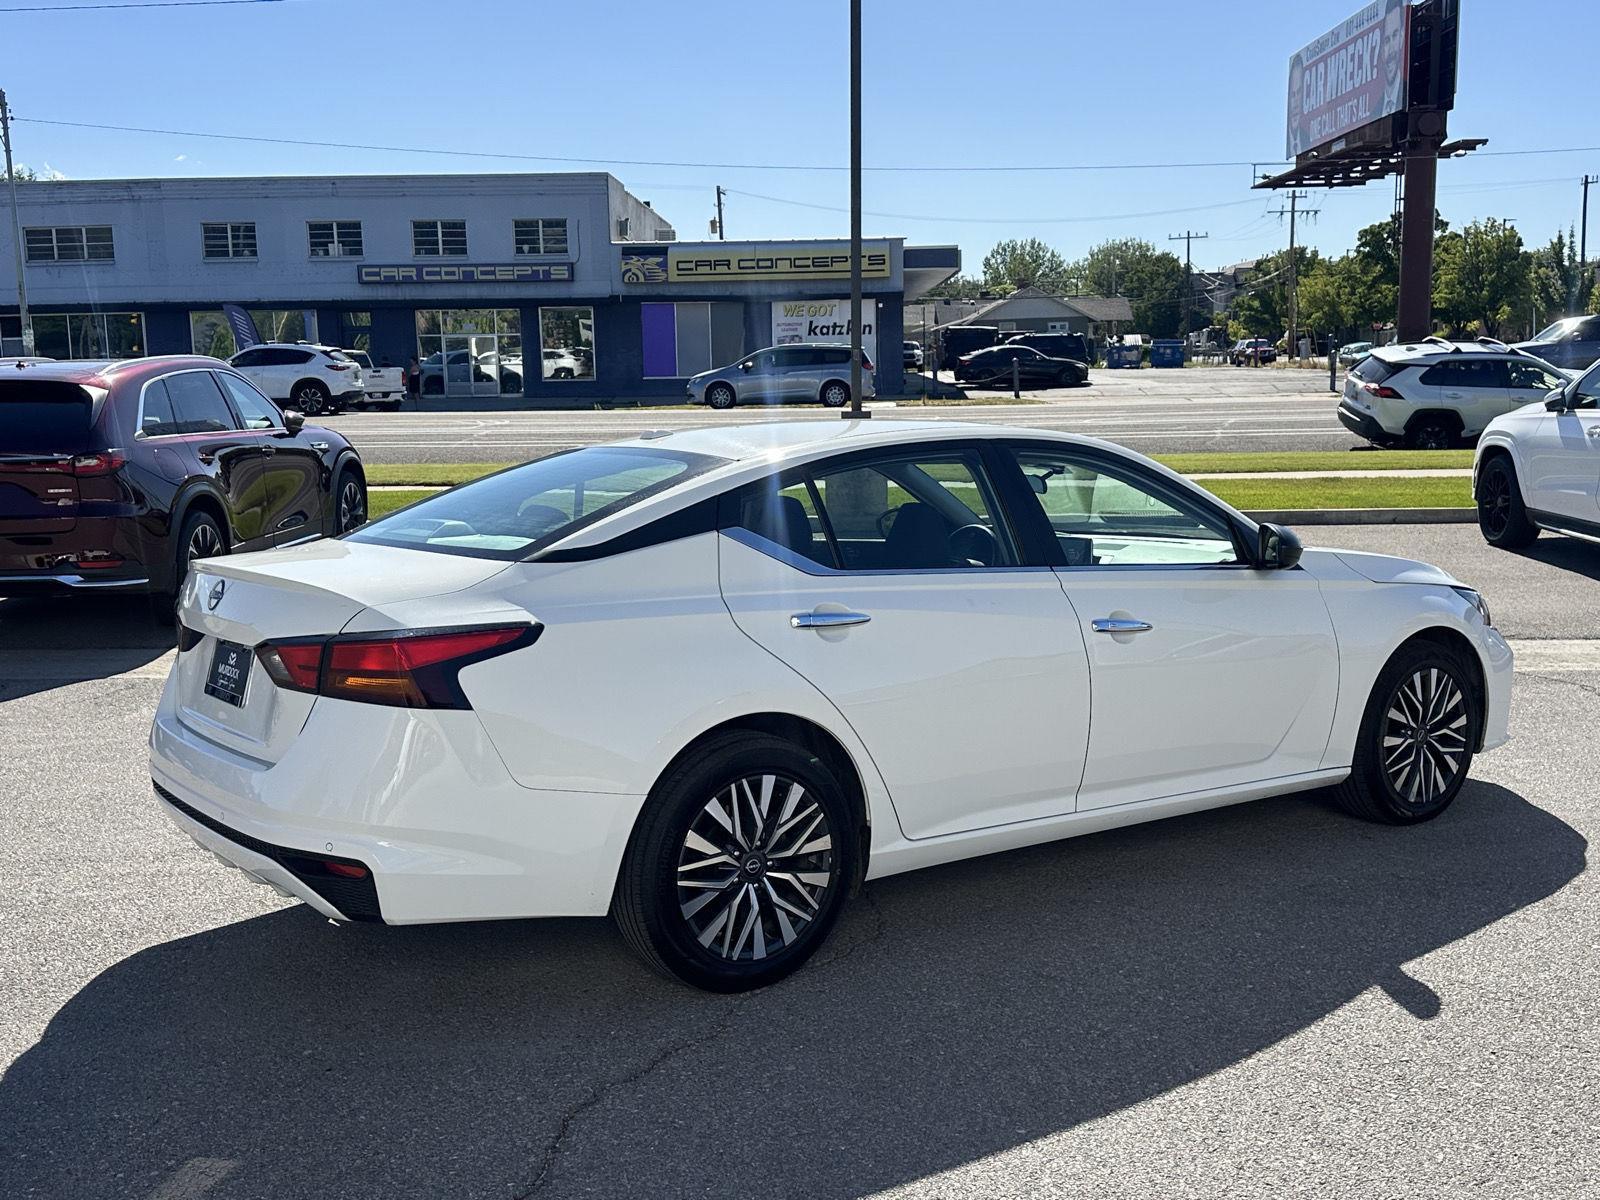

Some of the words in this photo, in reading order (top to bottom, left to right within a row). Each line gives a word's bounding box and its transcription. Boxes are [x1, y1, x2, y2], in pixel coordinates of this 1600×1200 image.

[1303, 63, 1324, 114] CAR
[1327, 28, 1381, 104] WRECK?
[1321, 109, 1336, 137] CALL
[1337, 98, 1358, 130] THAT'S
[1358, 92, 1370, 120] ALL
[676, 258, 731, 272] CAR
[737, 254, 886, 270] CONCEPS
[362, 266, 417, 281] CAR
[422, 265, 568, 280] CONCEPTS
[783, 304, 804, 317] WE
[807, 303, 837, 317] GOT
[807, 319, 873, 336] katzkn
